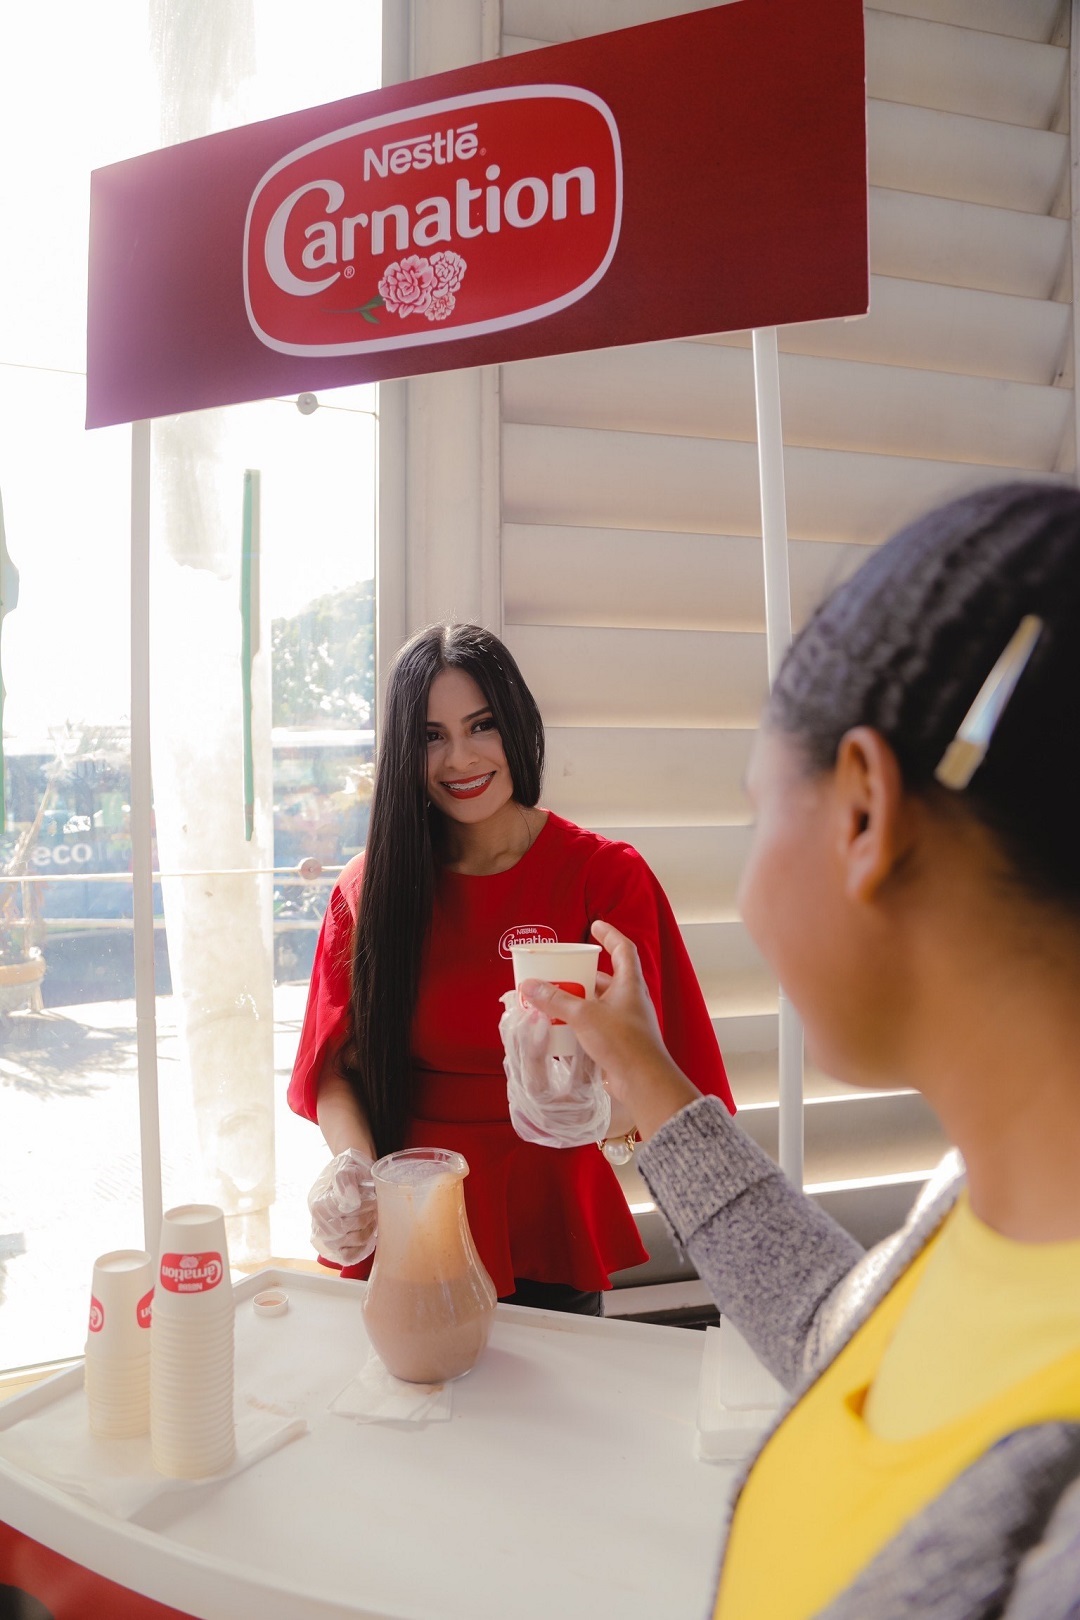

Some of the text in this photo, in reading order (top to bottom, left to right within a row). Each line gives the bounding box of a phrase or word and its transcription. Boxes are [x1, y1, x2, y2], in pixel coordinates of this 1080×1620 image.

[363, 122, 479, 182] Nestlé
[264, 164, 596, 297] Carnation
[162, 1260, 222, 1284] Carnation
